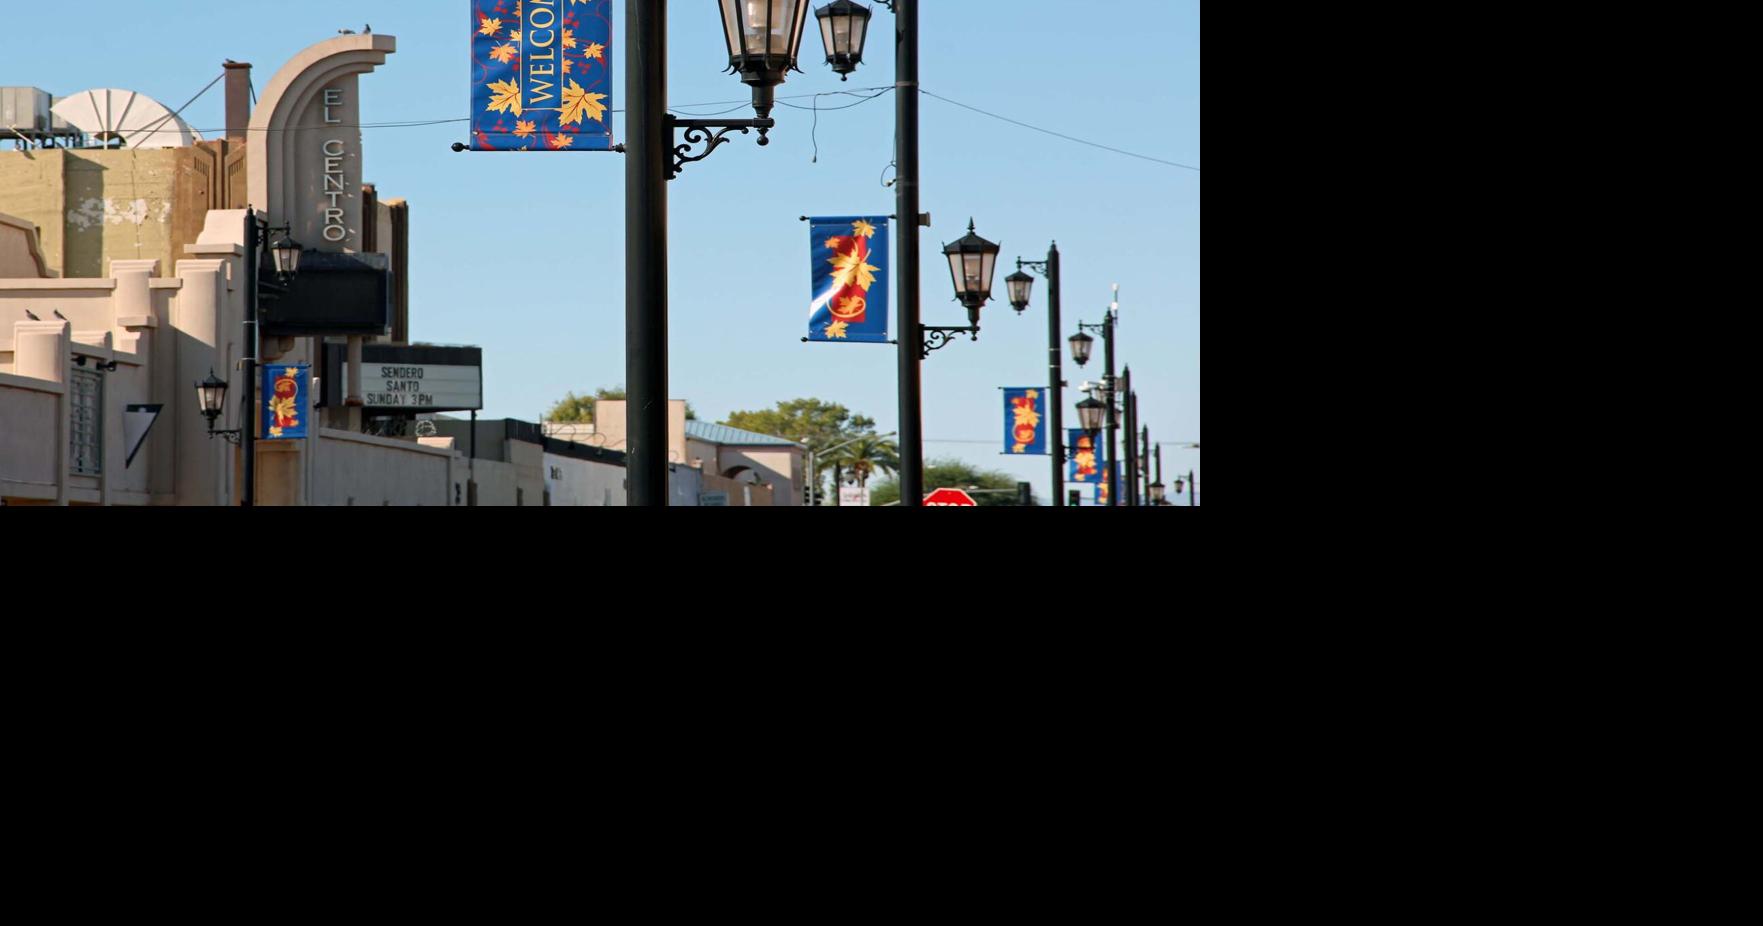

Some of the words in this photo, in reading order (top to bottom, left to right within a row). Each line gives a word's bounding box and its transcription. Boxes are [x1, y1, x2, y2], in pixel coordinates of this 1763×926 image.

[529, 0, 555, 104] WELCO
[323, 88, 343, 123] EL
[322, 139, 346, 241] CENTRO
[380, 366, 424, 379] SENDERO
[386, 380, 420, 392] SANTO
[366, 393, 406, 405] SUNDAY
